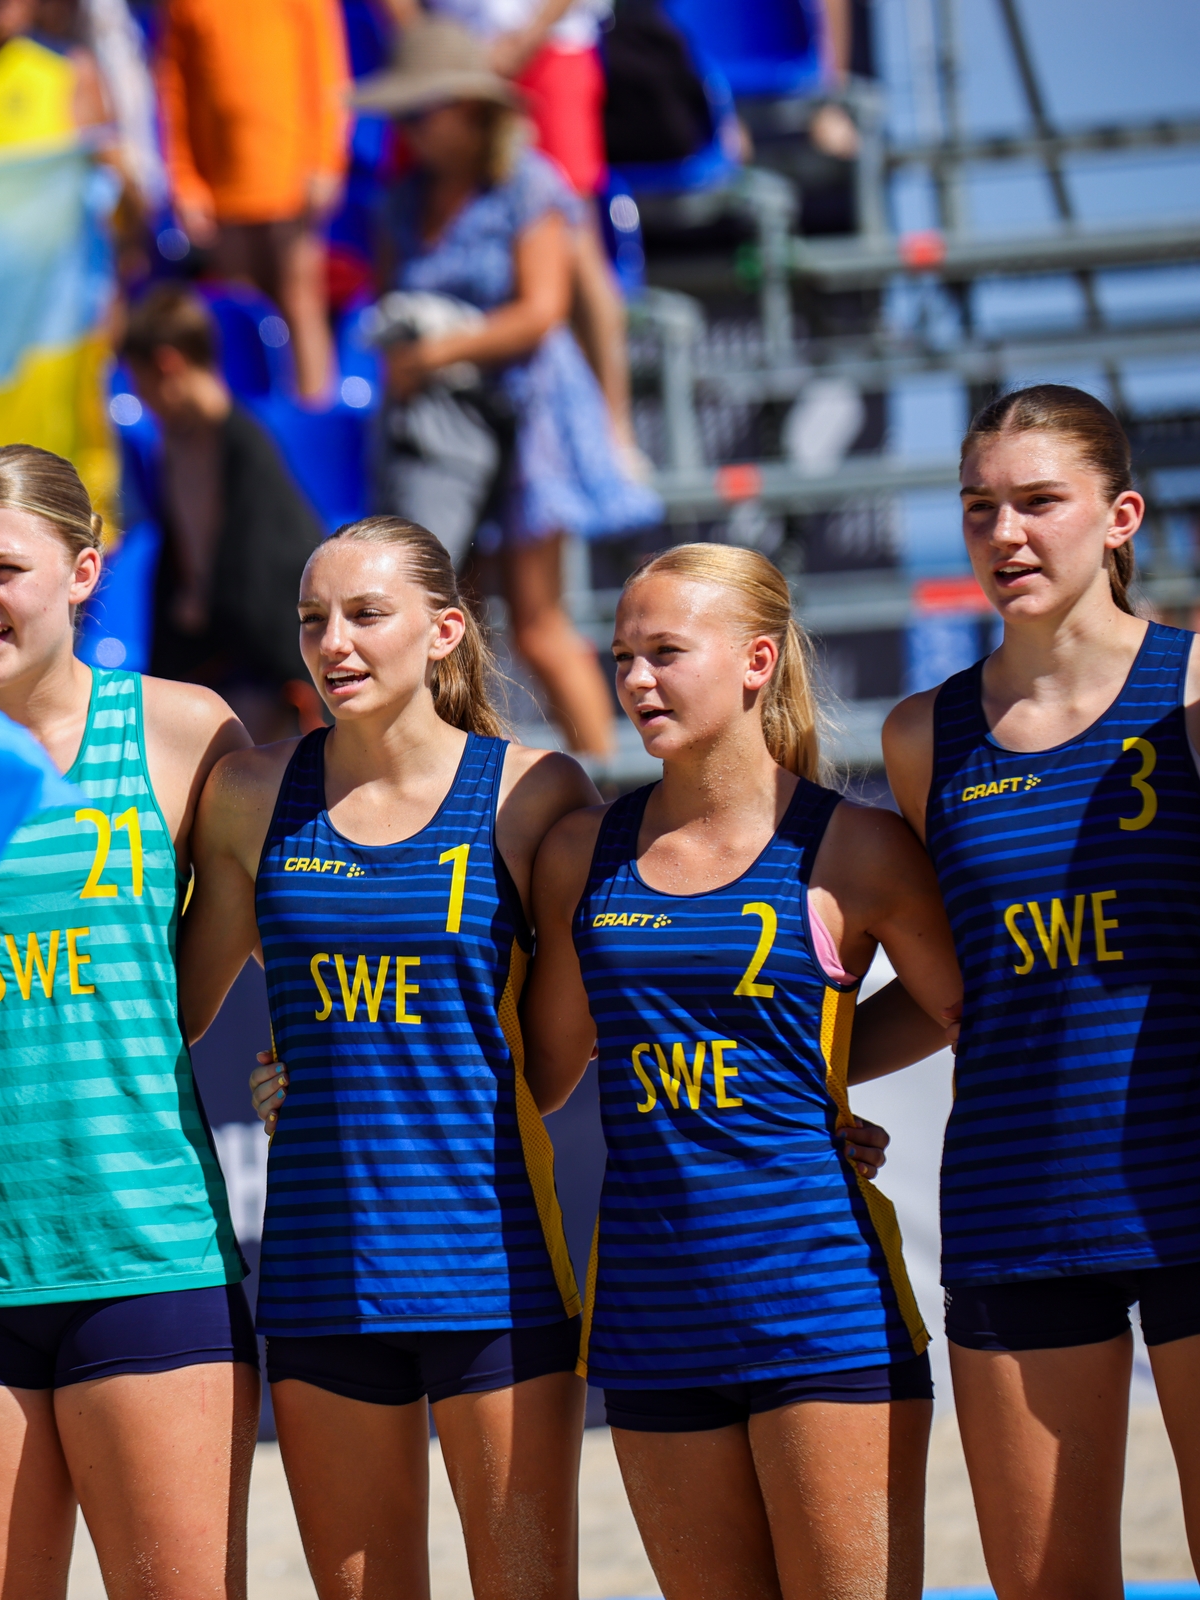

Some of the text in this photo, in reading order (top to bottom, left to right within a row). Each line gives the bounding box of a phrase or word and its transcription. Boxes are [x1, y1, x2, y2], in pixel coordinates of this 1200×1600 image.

[962, 777, 1023, 802] CRAFT
[1119, 736, 1158, 831] 3
[75, 806, 144, 899] 21
[283, 857, 346, 875] CRAFT
[438, 843, 471, 934] 1
[592, 913, 654, 928] CRAFT
[733, 902, 778, 998] 2
[1004, 889, 1124, 975] SWE
[309, 952, 422, 1025] SWE
[631, 1039, 744, 1113] SWE
